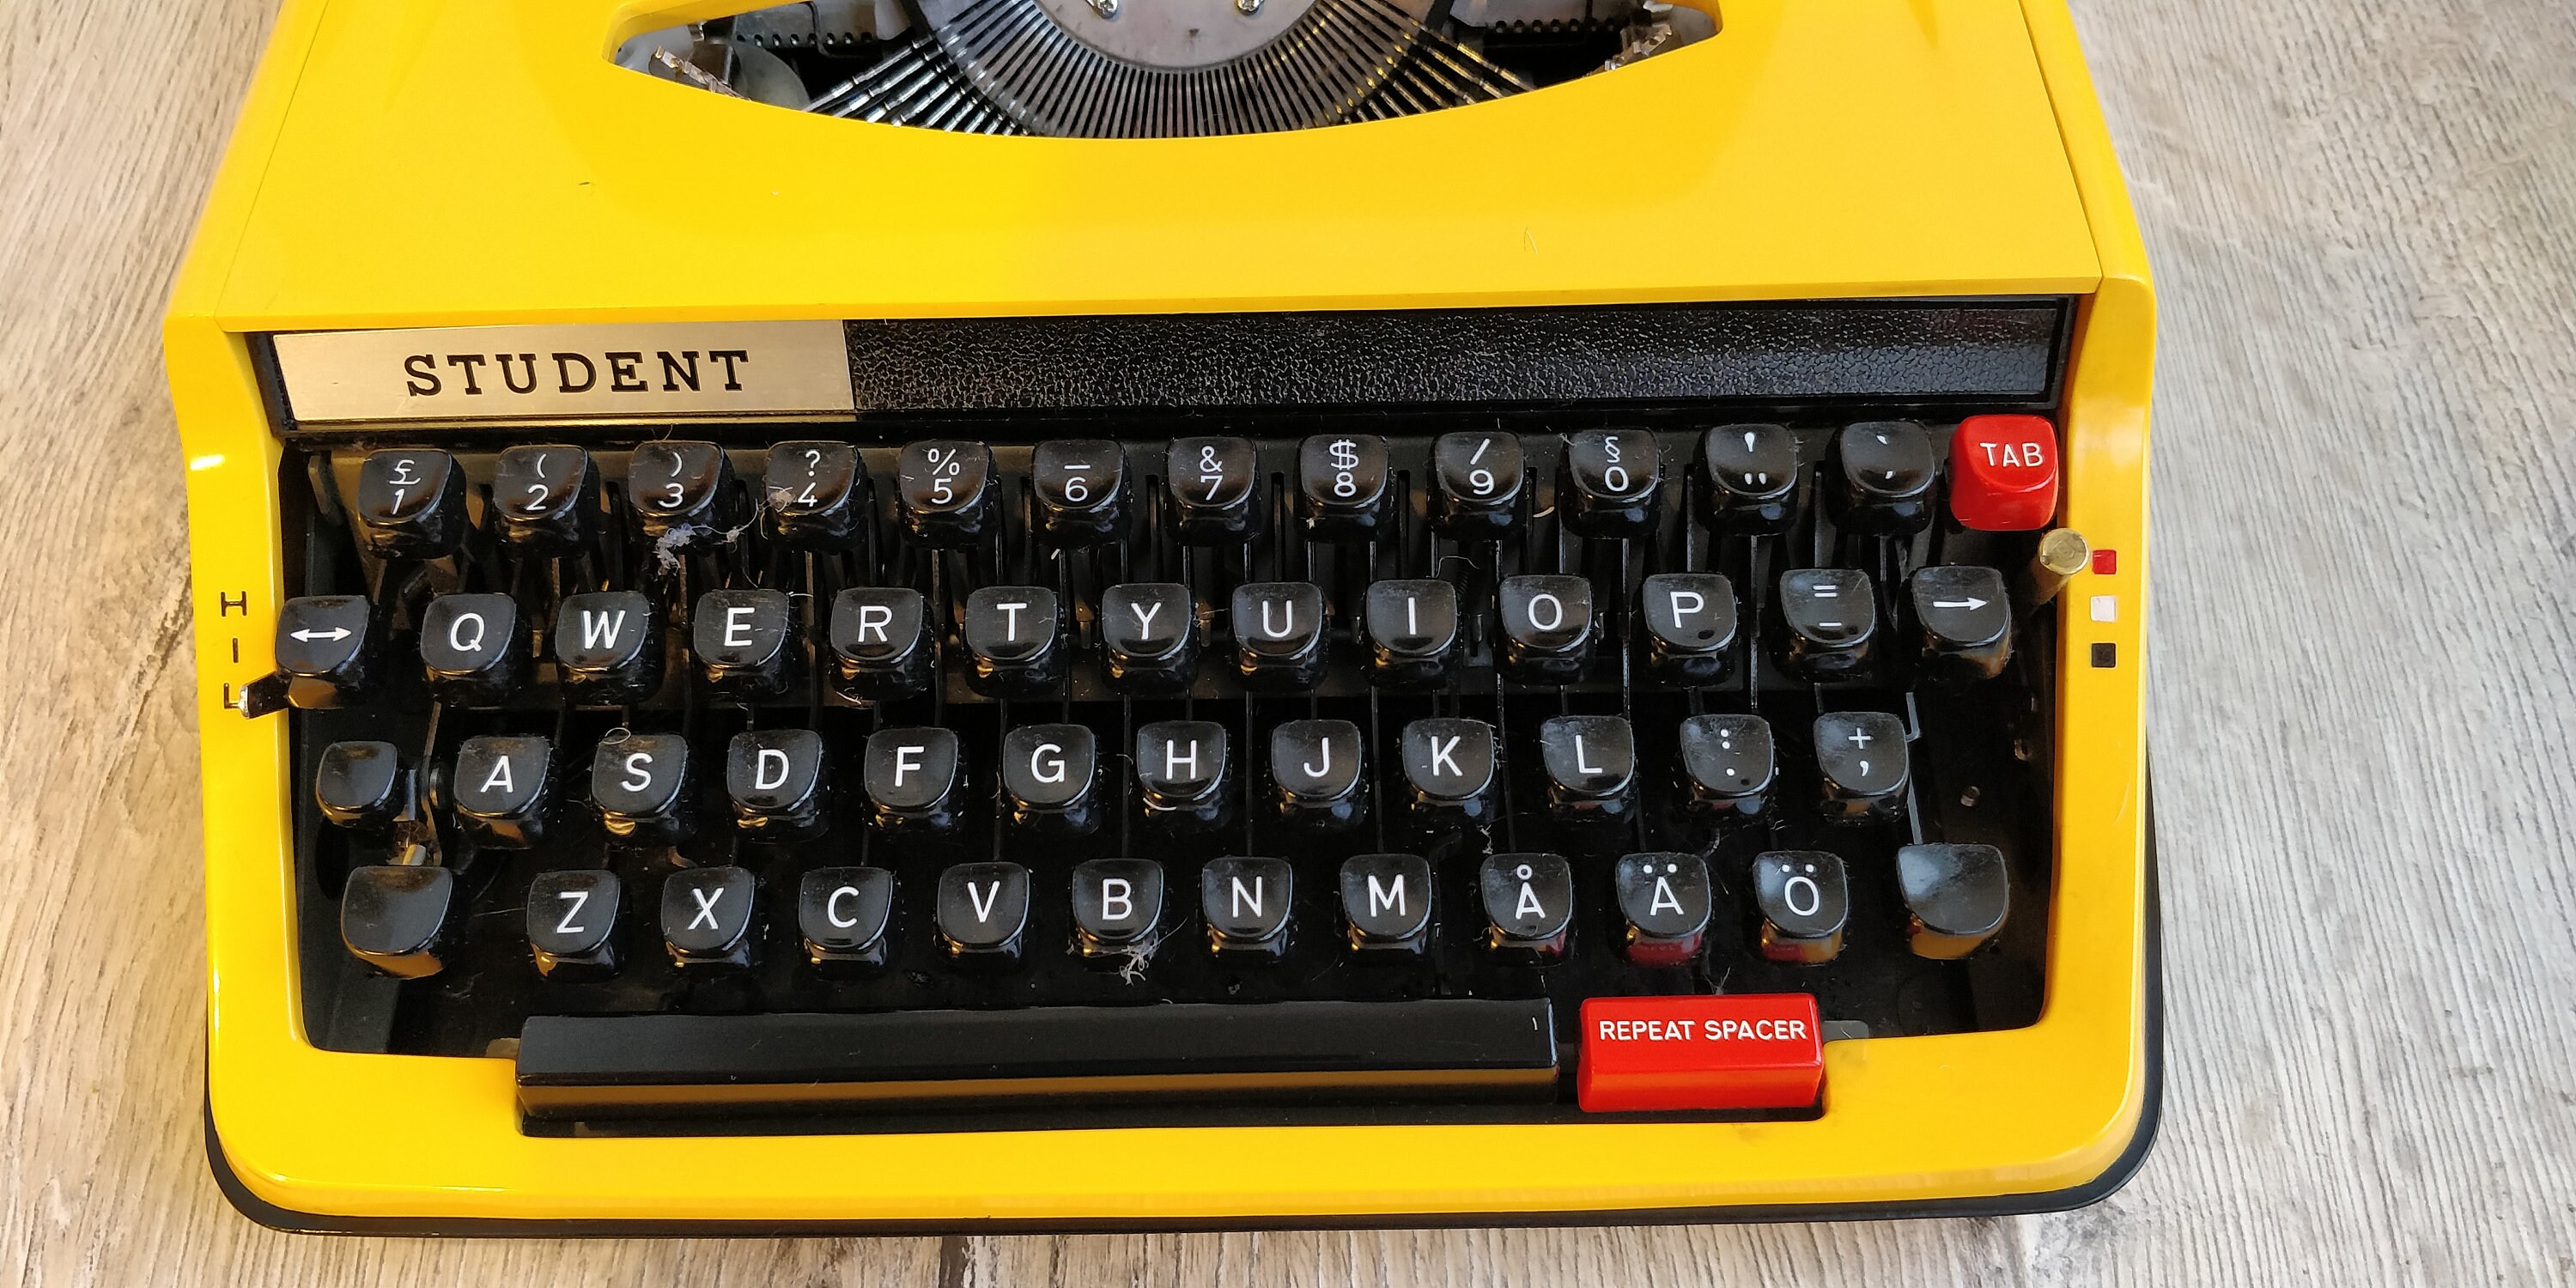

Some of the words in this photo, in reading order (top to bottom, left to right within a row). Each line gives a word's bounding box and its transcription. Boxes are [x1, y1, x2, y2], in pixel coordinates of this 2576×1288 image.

[404, 349, 750, 398] STUDENT
[536, 453, 548, 479] (
[670, 451, 683, 478] )
[805, 449, 822, 477] ?
[927, 447, 961, 477] %
[1199, 445, 1224, 474] &
[1328, 438, 1360, 471] $
[1469, 437, 1491, 466] /
[1604, 435, 1621, 464] §
[1978, 441, 2044, 468] TAB
[388, 459, 422, 486] £
[930, 477, 954, 505] 5
[1064, 476, 1089, 502] 6
[1200, 474, 1224, 501] 7
[1333, 471, 1358, 498] 8
[1468, 468, 1495, 496] 9
[392, 487, 406, 516] 1
[525, 483, 550, 512] 2
[658, 482, 685, 508] 3
[797, 481, 819, 508] 4
[220, 590, 248, 617] H
[1669, 590, 1705, 629] P
[1812, 584, 1838, 598] =
[582, 609, 627, 650] W
[723, 606, 756, 647] E
[857, 605, 893, 643] R
[995, 602, 1028, 642] T
[1130, 601, 1163, 641] Y
[1261, 599, 1293, 639] U
[1406, 596, 1418, 636] I
[1527, 592, 1564, 631] O
[449, 611, 486, 653] Q
[222, 682, 240, 709] L
[1303, 736, 1331, 779] J
[1430, 735, 1464, 777] K
[1574, 733, 1604, 775] L
[1847, 726, 1872, 750] +
[479, 754, 514, 794] A
[621, 751, 654, 793] S
[754, 748, 790, 791] D
[894, 745, 926, 788] F
[1030, 743, 1066, 784] G
[1165, 738, 1198, 781] H
[1858, 759, 1870, 778] ,
[687, 886, 725, 931] X
[826, 885, 860, 929] C
[966, 880, 1001, 924] V
[1101, 878, 1133, 921] B
[1231, 875, 1263, 919] N
[1367, 873, 1406, 918] M
[1514, 863, 1546, 920] Å
[1642, 862, 1685, 917] Ä
[1780, 863, 1820, 917] Ö
[556, 890, 590, 934] Z
[1599, 1019, 1696, 1042] REPEAT
[1704, 1018, 1807, 1042] SPACER
